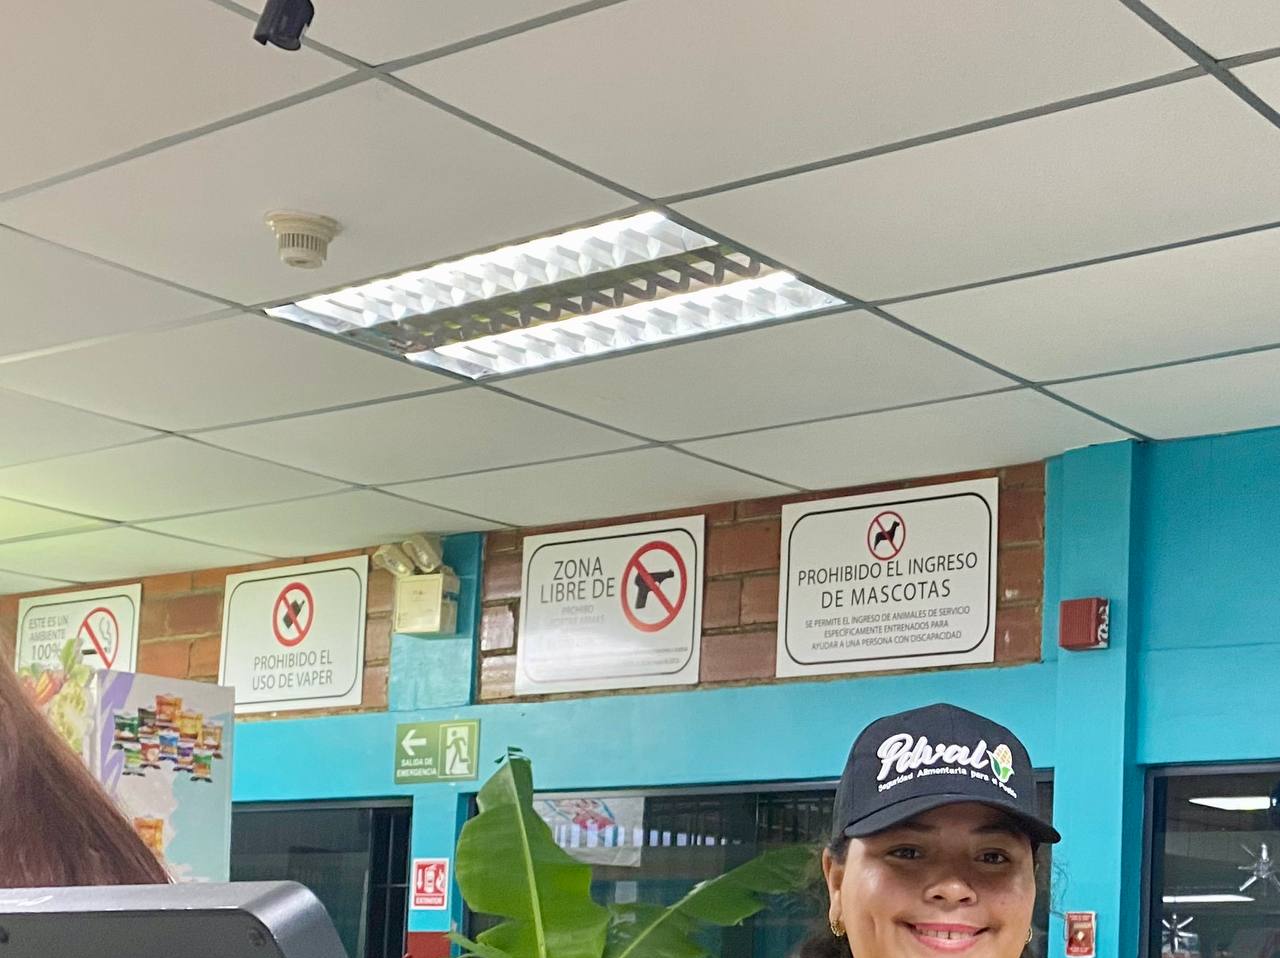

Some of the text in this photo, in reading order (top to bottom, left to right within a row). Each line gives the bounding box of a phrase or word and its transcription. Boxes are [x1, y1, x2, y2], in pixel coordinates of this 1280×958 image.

[553, 556, 603, 581] ZONA
[798, 552, 978, 586] PROHIBIDO EL INGRESO
[540, 577, 616, 604] LIBRE DE
[821, 579, 951, 609] DE MASCOTAS
[805, 605, 970, 628] SE PERMITE EL INGRESO DE ANIMALES DE SERVICIO
[884, 621, 930, 633] ENTRENADOS
[930, 619, 949, 629] PARA
[811, 630, 962, 650] AYUDAR A UNA PERSONA CON DISCAPACIDAD
[254, 649, 333, 672] PROHIBIDO EL
[252, 669, 333, 691] USO DE VAPER
